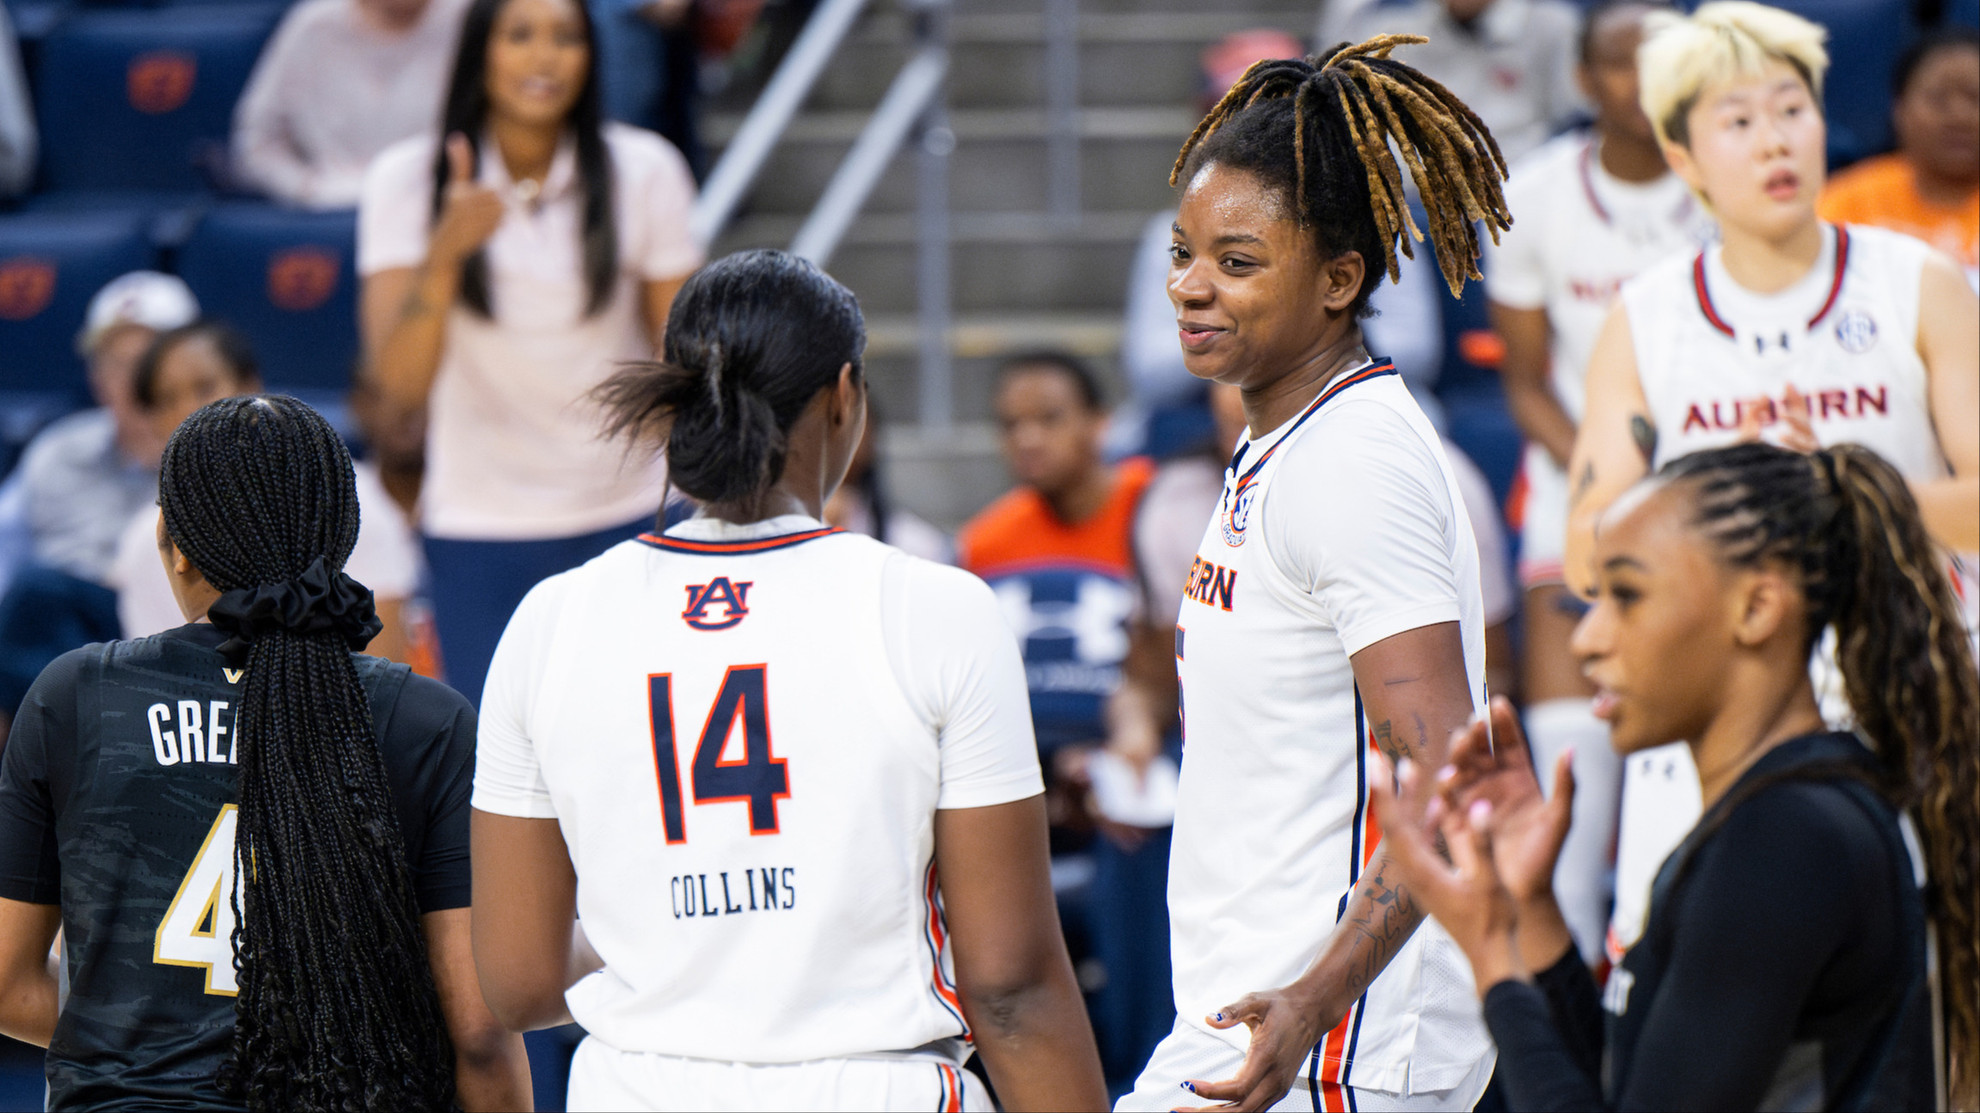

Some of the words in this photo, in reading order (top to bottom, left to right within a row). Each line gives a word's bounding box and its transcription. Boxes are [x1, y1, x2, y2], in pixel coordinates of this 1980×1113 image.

[1681, 384, 1888, 436] AURN
[647, 662, 792, 846] 14
[153, 803, 250, 997] 4
[670, 867, 796, 920] COLLINS
